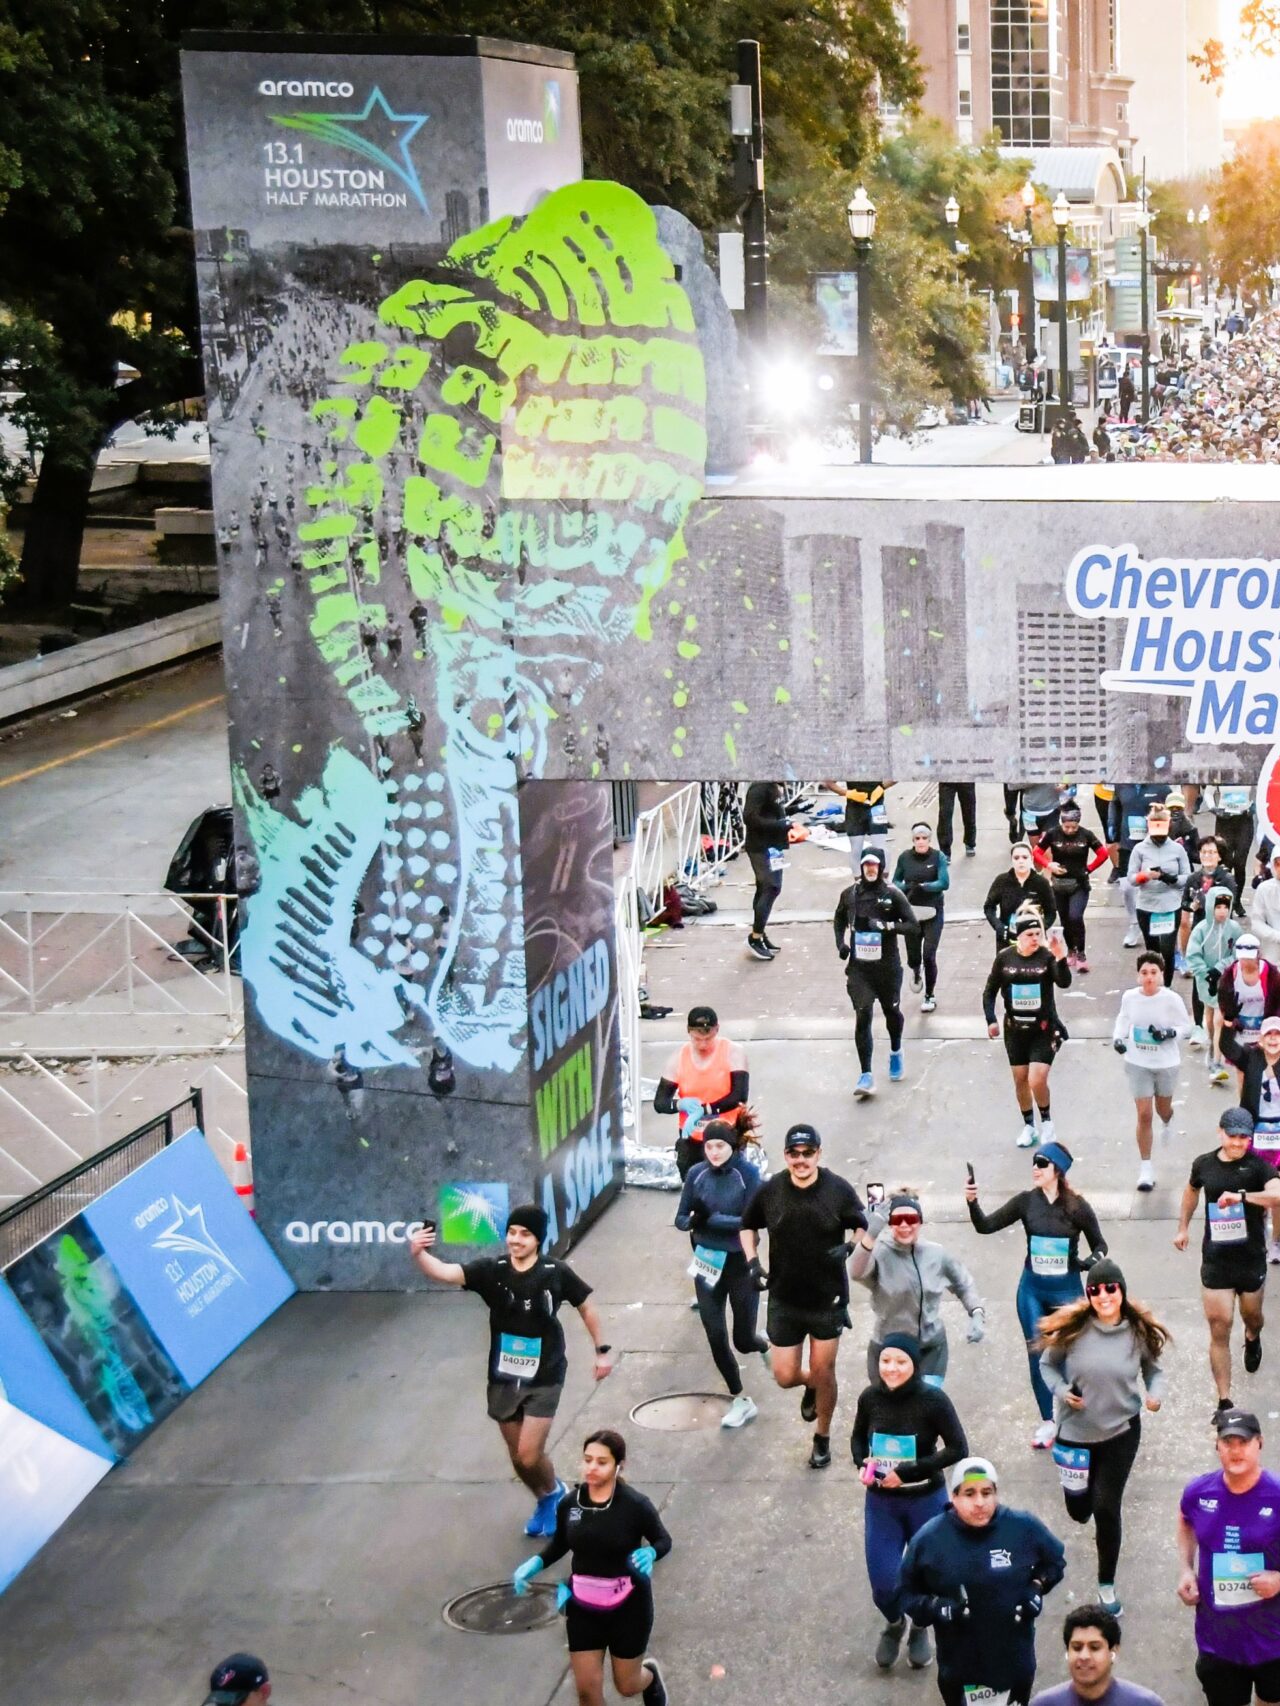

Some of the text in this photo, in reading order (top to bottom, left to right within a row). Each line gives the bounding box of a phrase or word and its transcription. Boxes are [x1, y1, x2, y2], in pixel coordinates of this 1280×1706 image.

[258, 79, 354, 98] aramco
[506, 117, 544, 144] aramco
[263, 142, 303, 165] 13.1
[264, 168, 386, 190] HOUSTON
[266, 191, 408, 208] HALF MARATHON
[532, 937, 611, 1073] SIGNED
[534, 1041, 594, 1162] WITH
[540, 1110, 613, 1255] A SOLE
[134, 1197, 169, 1230] aramco
[176, 1259, 220, 1304] HOUSTON
